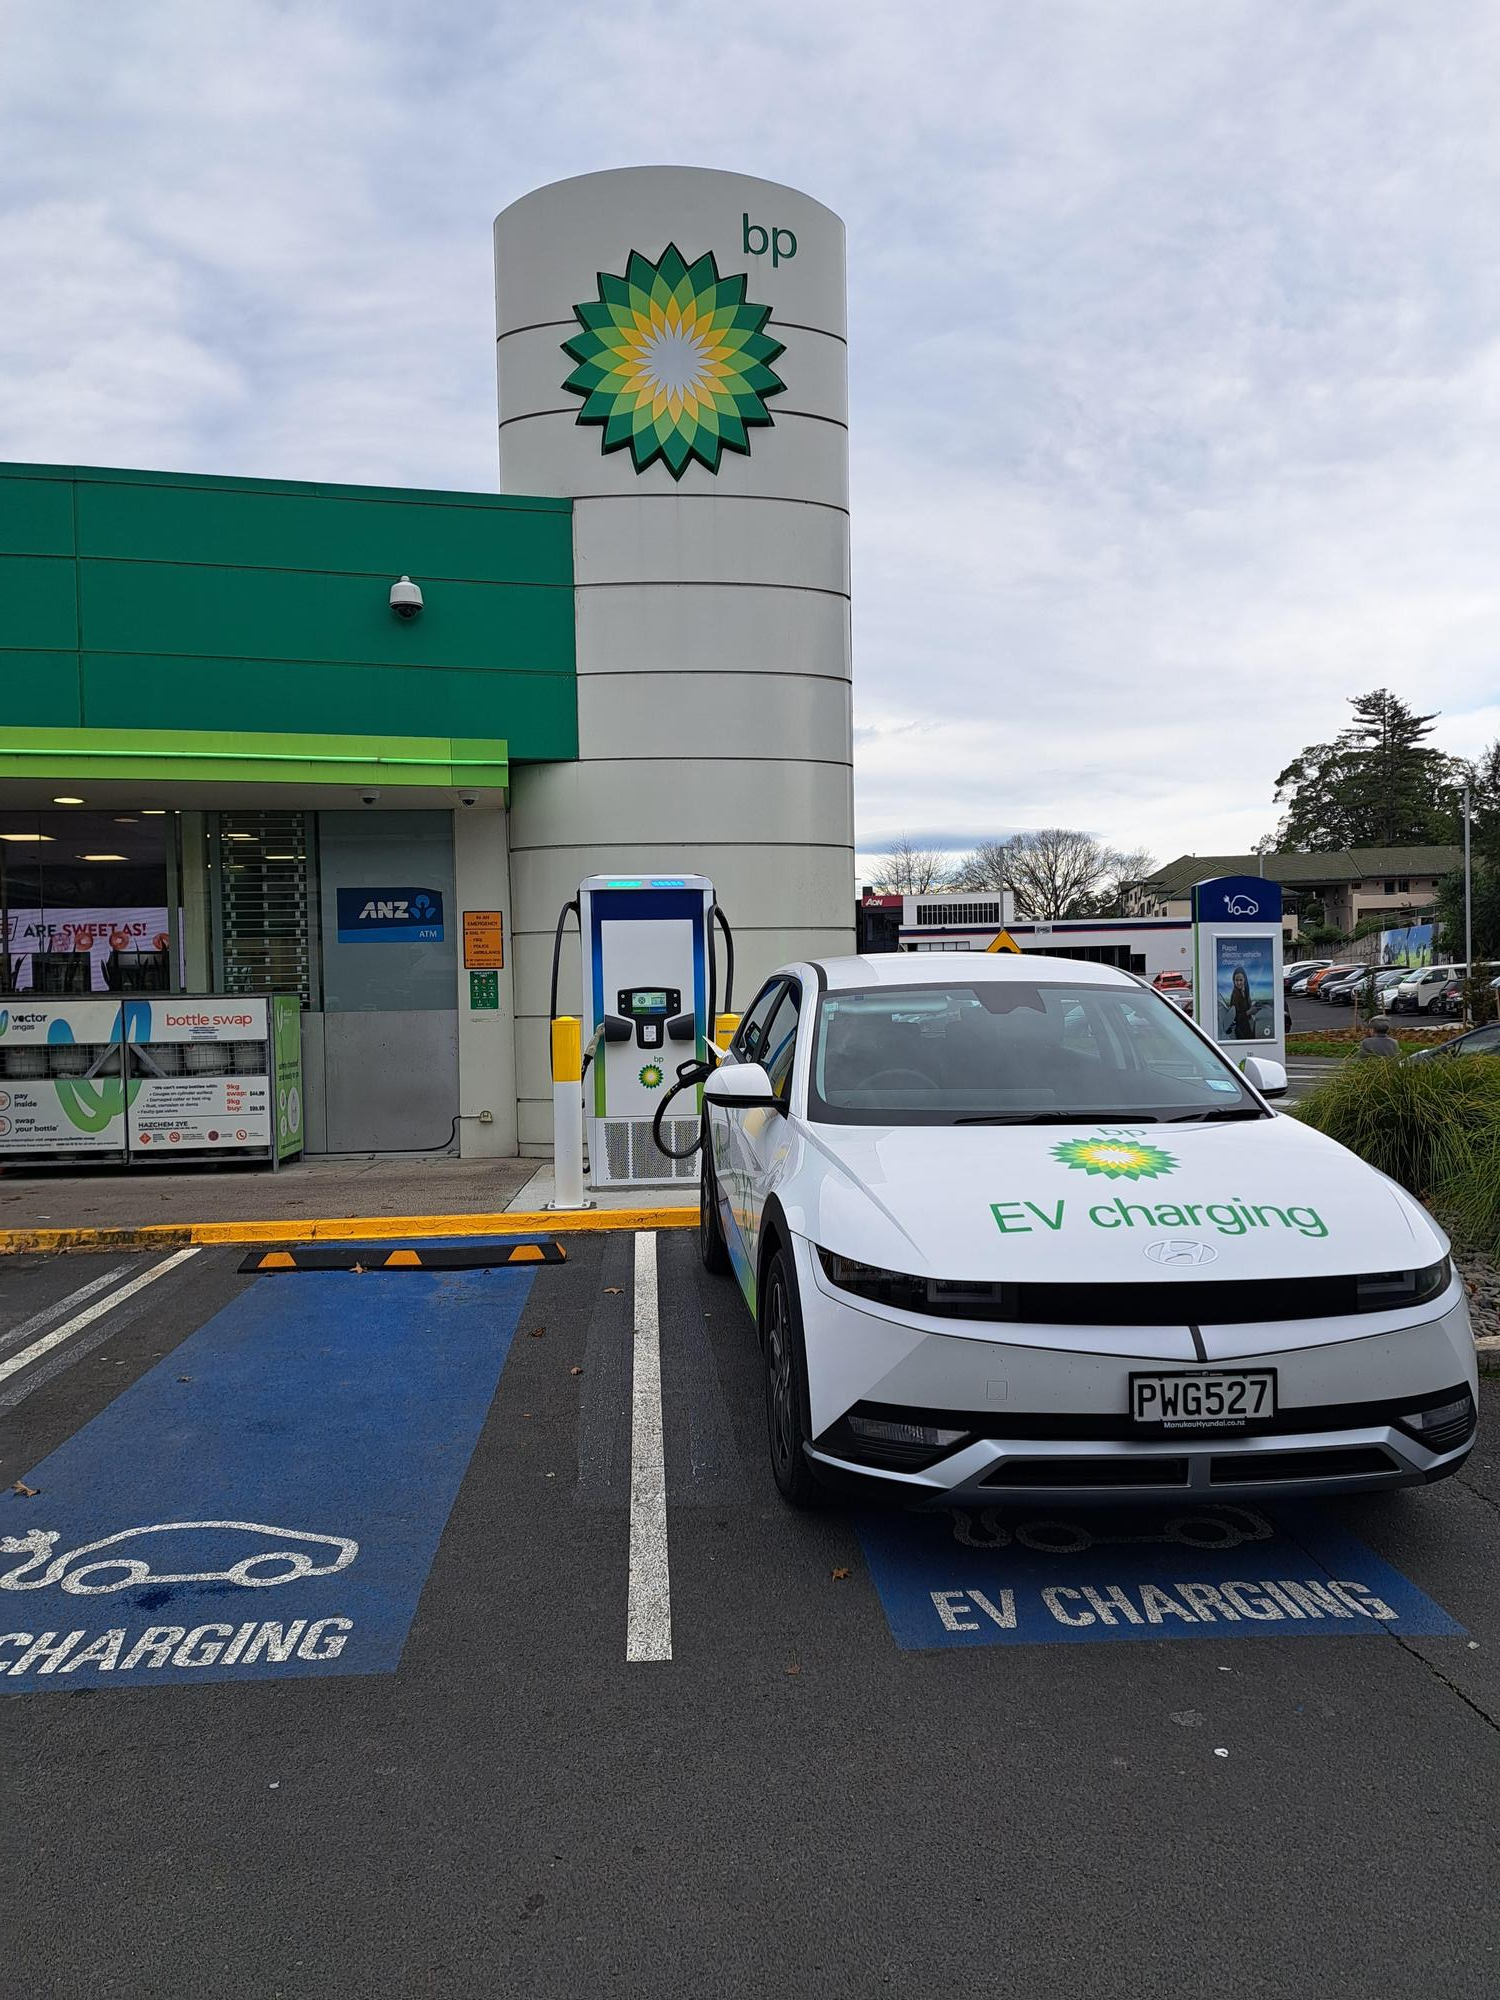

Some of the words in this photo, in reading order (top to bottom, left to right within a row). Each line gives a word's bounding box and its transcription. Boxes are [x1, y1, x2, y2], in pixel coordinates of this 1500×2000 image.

[743, 213, 797, 268] bp
[359, 902, 409, 919] ANZ
[23, 924, 56, 938] ARE
[62, 923, 118, 937] SWEET
[122, 923, 147, 937] AS!
[419, 930, 437, 938] ATM
[11, 1013, 48, 1023] vector
[166, 1013, 210, 1027] bottle
[212, 1014, 253, 1028] swap
[11, 1024, 35, 1032] ongas
[653, 1056, 664, 1064] bp
[1096, 1127, 1148, 1138] bp
[989, 1199, 1065, 1234] EV
[1088, 1197, 1330, 1238] charging
[1137, 1380, 1268, 1418] PWG527
[1163, 1419, 1246, 1429] ManukauHyundai.co.nz
[929, 1588, 1018, 1632] EV
[1039, 1580, 1399, 1627] CHARGING
